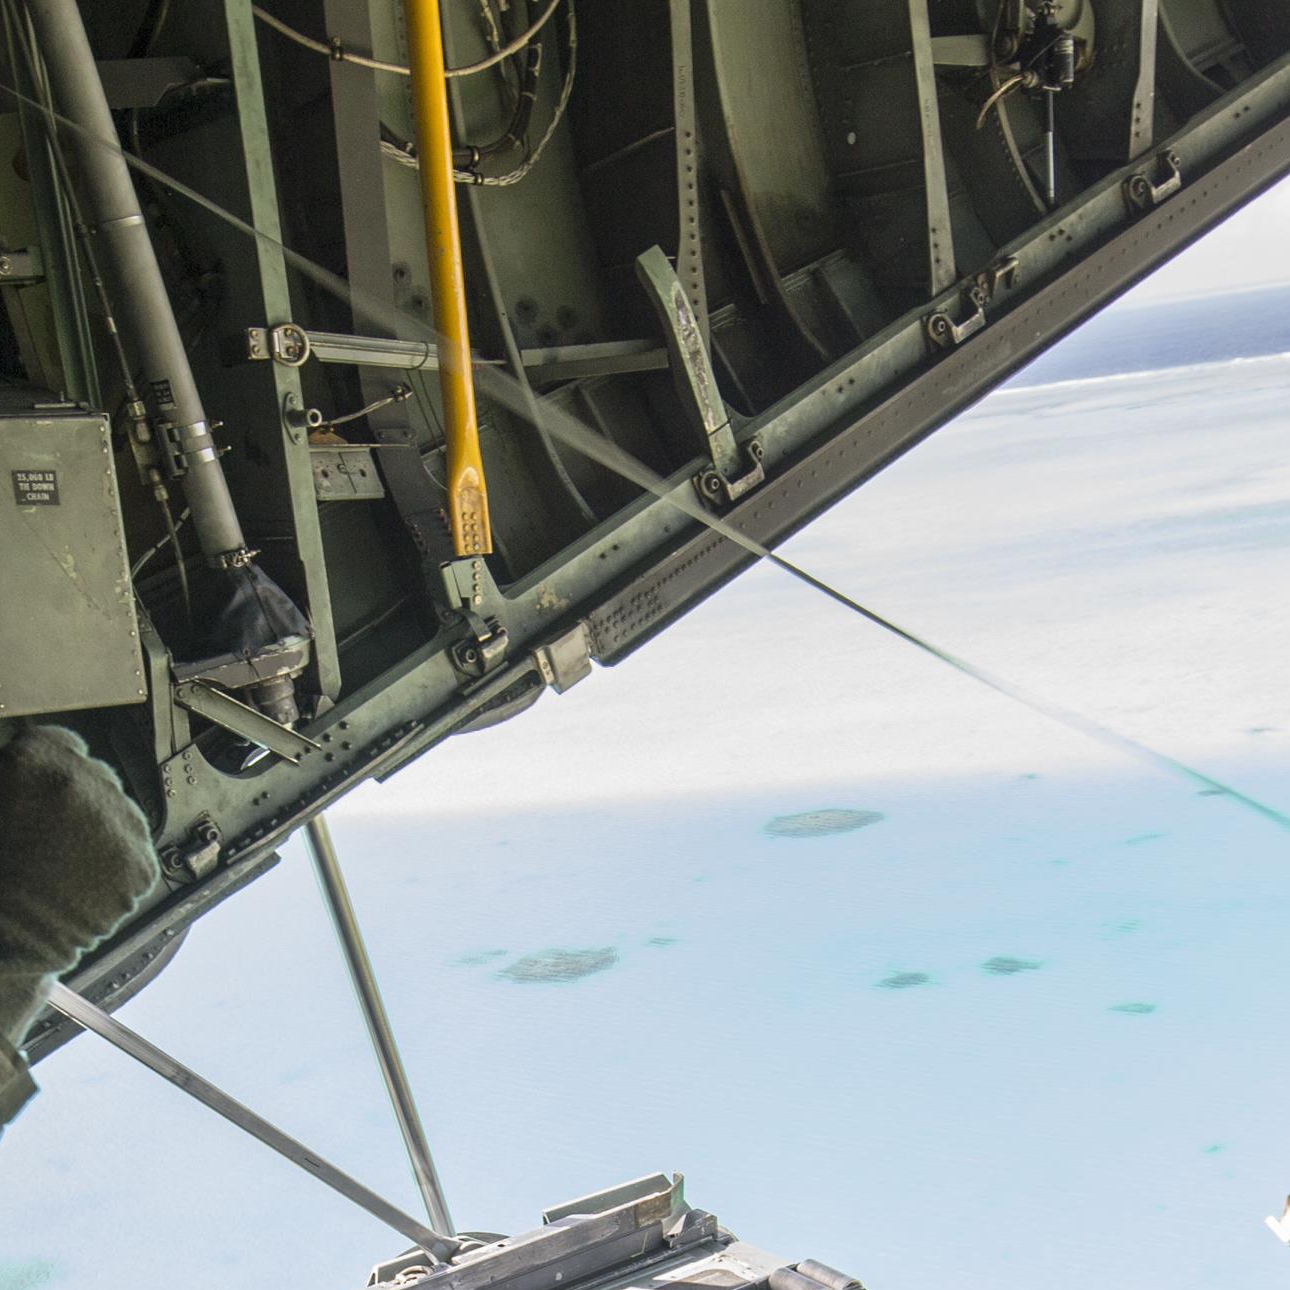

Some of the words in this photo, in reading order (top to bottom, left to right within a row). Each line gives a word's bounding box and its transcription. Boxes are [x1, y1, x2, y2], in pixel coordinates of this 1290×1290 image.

[19, 483, 30, 491] TIE
[32, 483, 55, 491] DOWN
[26, 492, 50, 501] CHAIN
